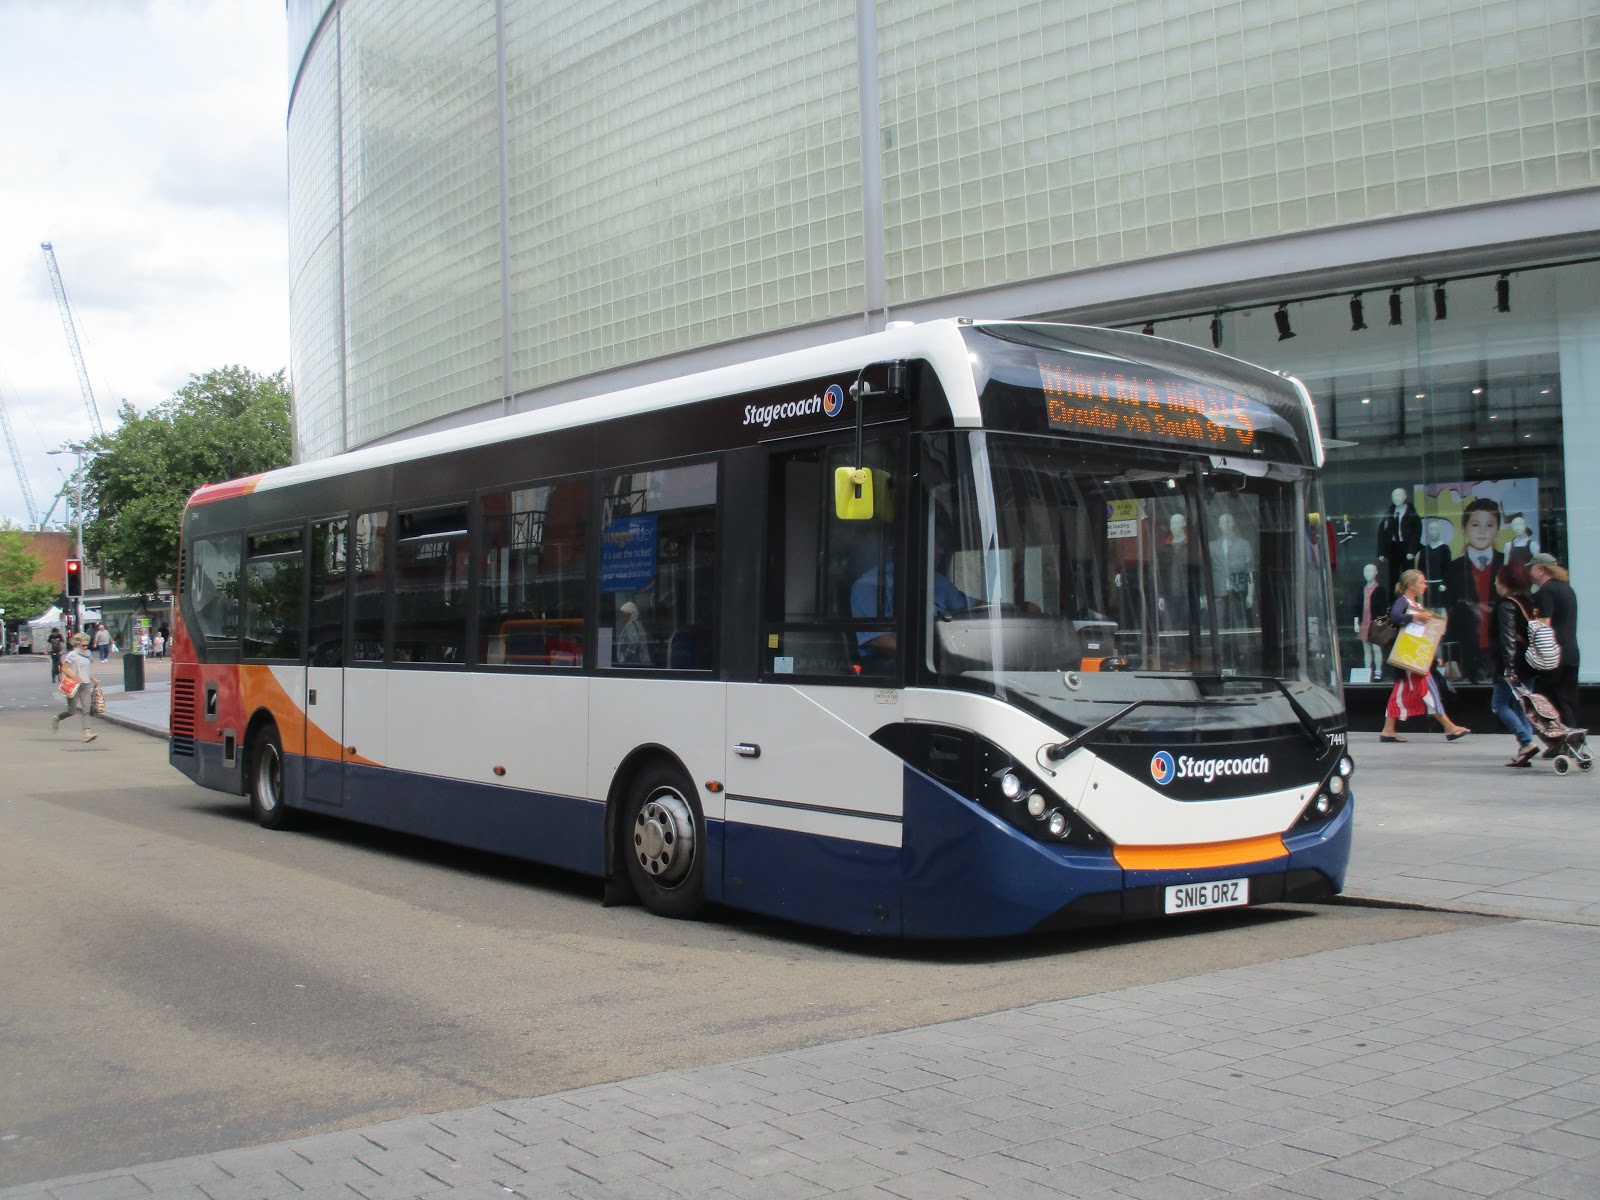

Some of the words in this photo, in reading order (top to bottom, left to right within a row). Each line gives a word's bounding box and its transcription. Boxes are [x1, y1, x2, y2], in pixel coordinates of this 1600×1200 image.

[743, 394, 822, 428] Stagecoach
[1048, 399, 1118, 429] Circular
[1123, 411, 1151, 432] via
[1154, 413, 1204, 439] South
[1206, 421, 1227, 442] St
[1325, 733, 1345, 746] 7441
[1177, 754, 1270, 783] Stagecoach
[1175, 886, 1207, 909] SN16
[1212, 882, 1239, 904] ORZ
